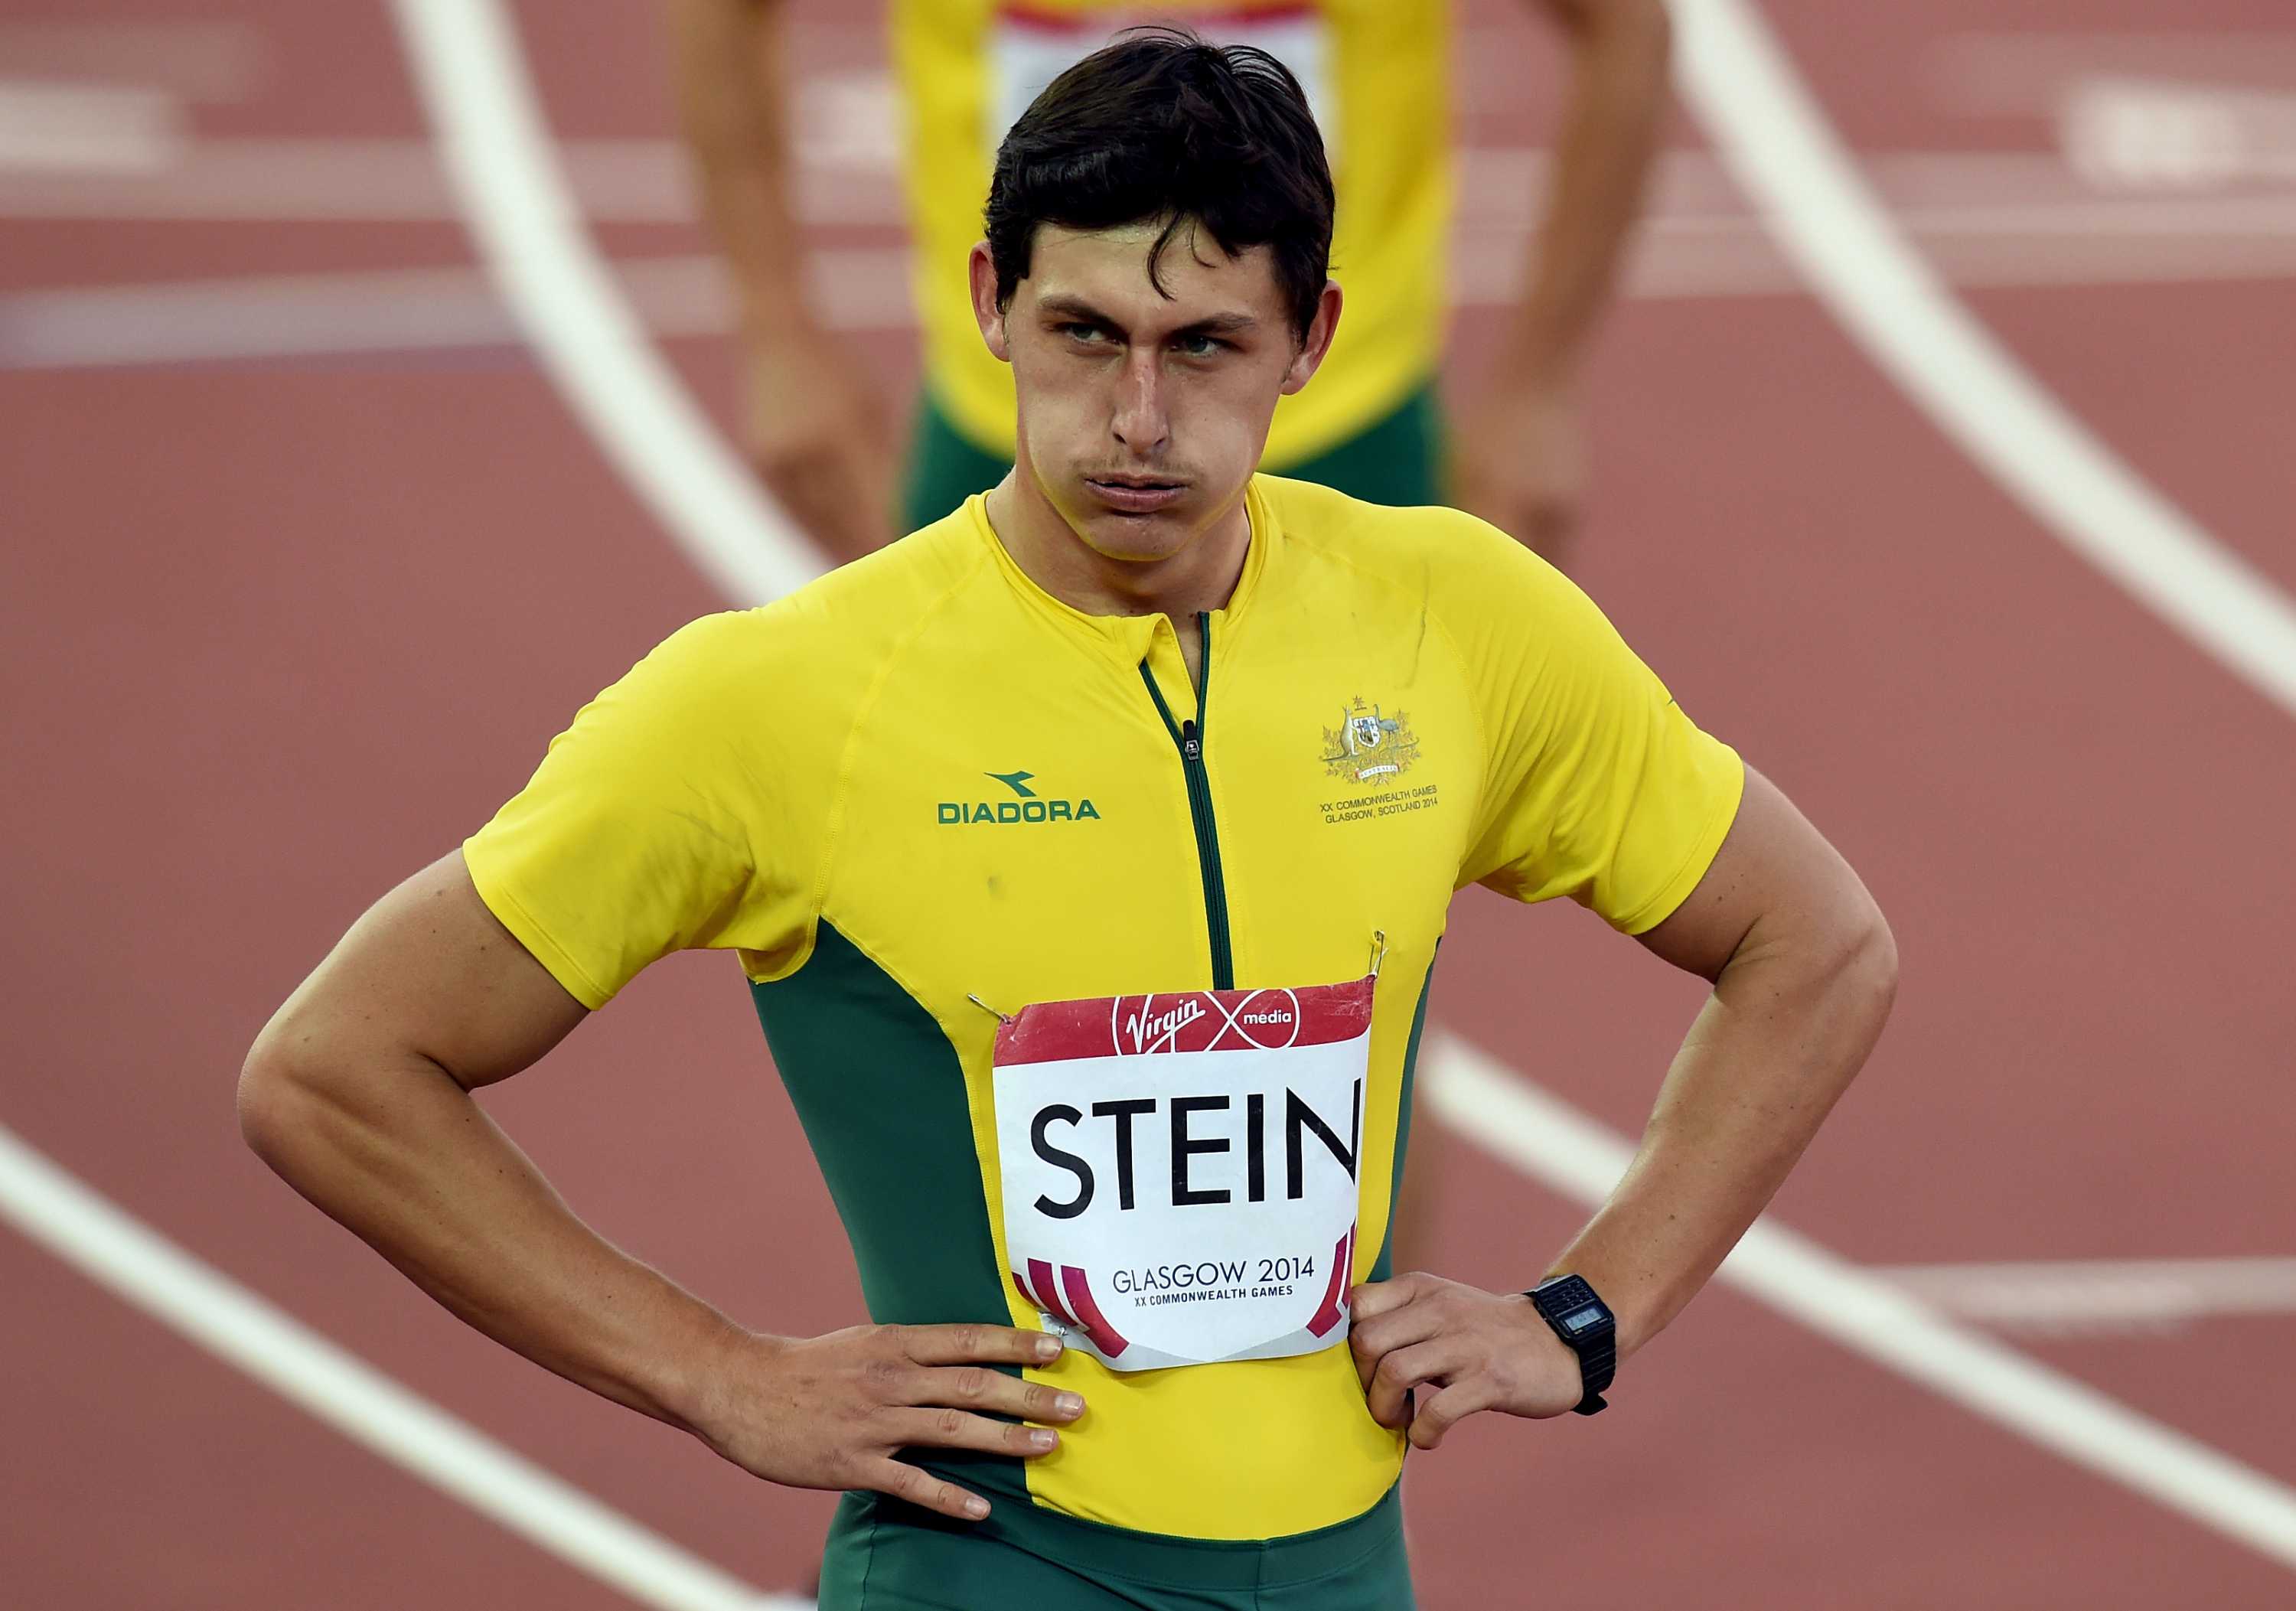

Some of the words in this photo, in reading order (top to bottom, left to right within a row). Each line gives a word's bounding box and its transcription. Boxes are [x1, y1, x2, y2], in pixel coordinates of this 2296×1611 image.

[938, 799, 1101, 823] DIADORA
[1320, 803, 1333, 813] XX
[1336, 791, 1411, 811] COMMONWEALTH
[1412, 784, 1437, 797] GAMES
[1325, 809, 1376, 824] GLASGOW,
[1378, 800, 1421, 817] SCOTLAND
[1423, 797, 1438, 809] 2014
[1126, 994, 1206, 1053] Virgin
[1244, 1009, 1292, 1025] media
[1030, 1078, 1362, 1219] STEIN
[1113, 1260, 1247, 1293] GLASGOW
[1258, 1255, 1315, 1282] 2014
[1134, 1296, 1147, 1307] XX
[1150, 1288, 1247, 1306] COMMONWEALTH
[1251, 1285, 1293, 1298] GAMES
